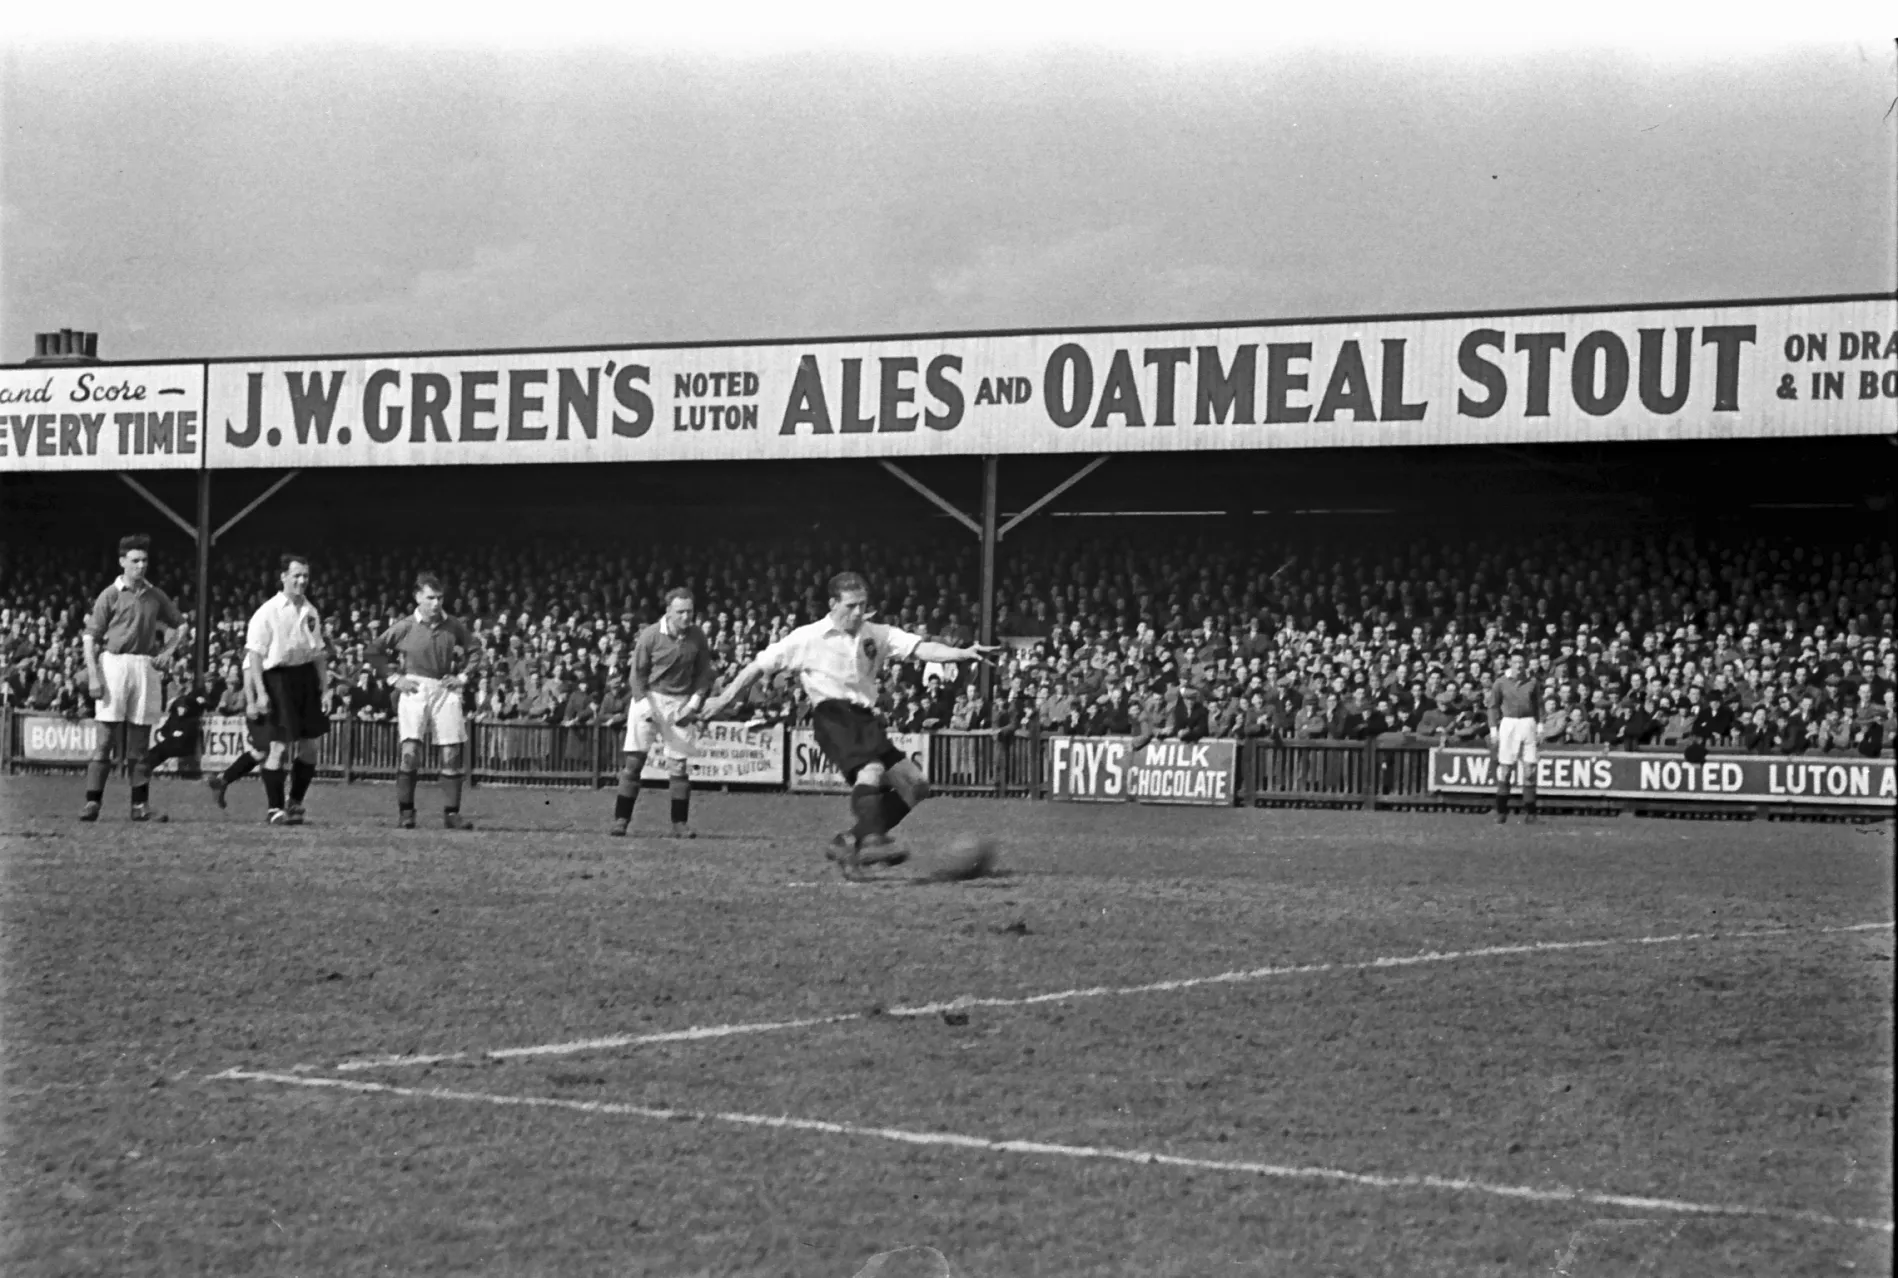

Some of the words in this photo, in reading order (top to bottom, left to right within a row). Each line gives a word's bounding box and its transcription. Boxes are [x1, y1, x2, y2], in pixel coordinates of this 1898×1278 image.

[1784, 333, 1828, 362] ON
[1839, 330, 1897, 361] DRA
[0, 376, 54, 403] and
[69, 373, 147, 401] Score
[673, 371, 760, 398] NOTED
[779, 354, 966, 435] ALES
[975, 377, 1033, 406] AND
[1043, 338, 1428, 429] OATMEAL
[1457, 324, 1757, 418] STOUT
[1776, 373, 1798, 400] &
[1811, 371, 1845, 400] IN
[1858, 370, 1897, 400] BO
[225, 370, 353, 448] J.W.
[363, 360, 654, 444] GREEN'S
[673, 404, 759, 431] LUTON
[114, 411, 197, 456] TIME
[200, 730, 250, 756] VESTA
[1145, 744, 1210, 768] MILK
[1053, 739, 1123, 797] FRY'S
[1127, 766, 1227, 800] CHOCOLATE
[1441, 755, 1494, 785] J.W.
[1496, 758, 1613, 790] EEN'S
[1641, 761, 1744, 793] NOTED
[1769, 763, 1870, 796] LUTON
